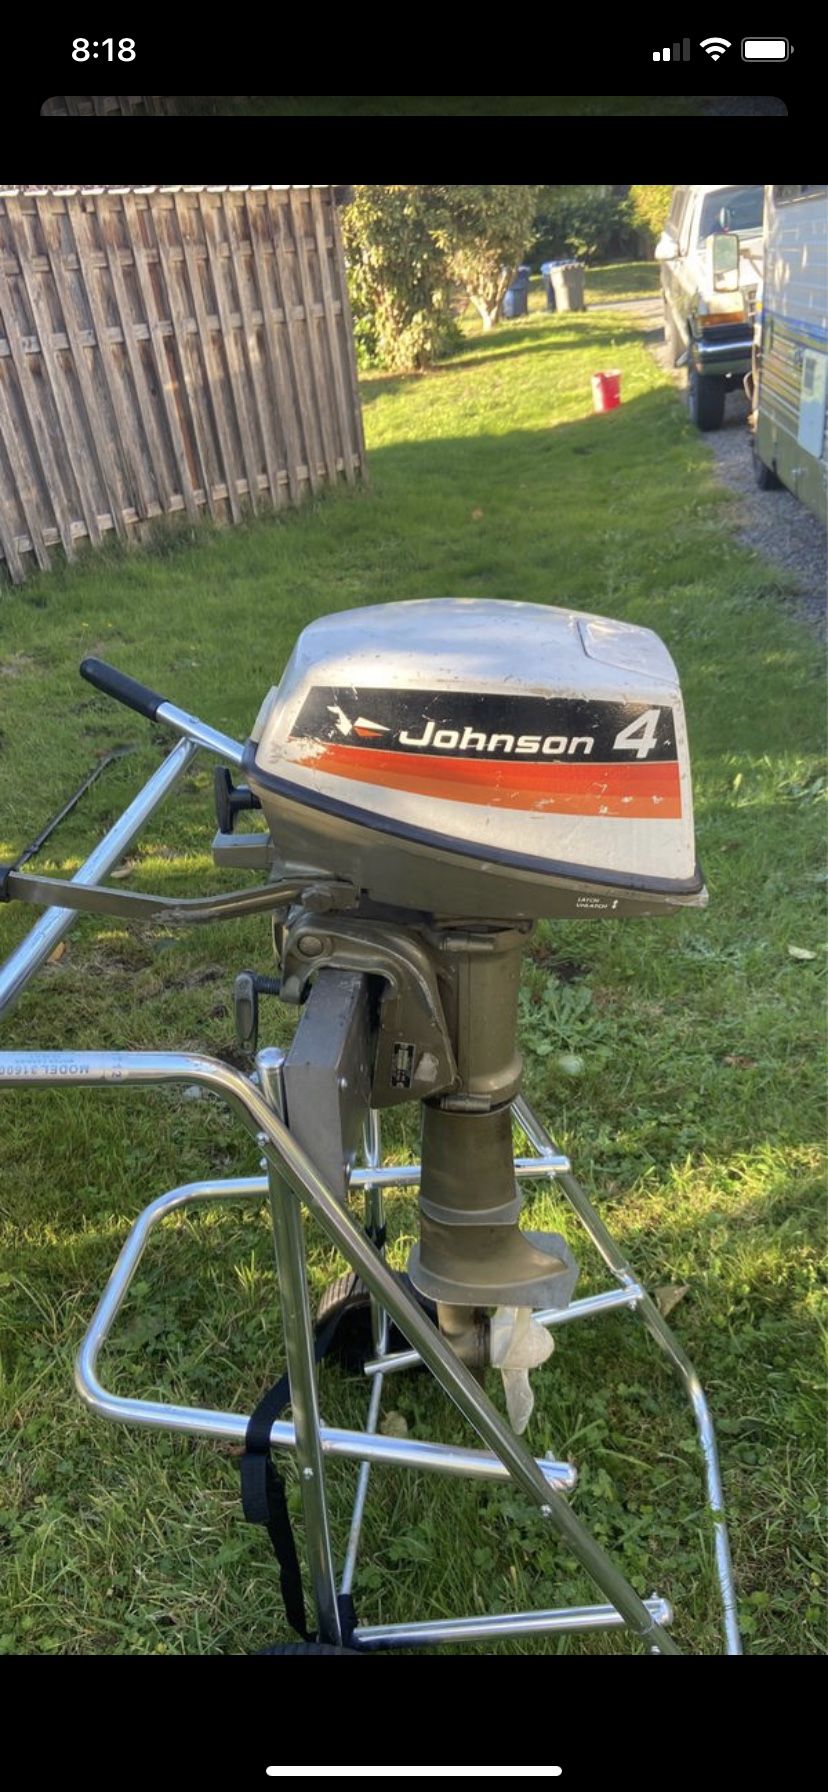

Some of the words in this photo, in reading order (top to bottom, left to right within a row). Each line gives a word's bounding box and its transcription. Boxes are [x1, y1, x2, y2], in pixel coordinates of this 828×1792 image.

[398, 721, 595, 755] Johnson
[612, 708, 661, 760] 4
[42, 1064, 89, 1075] MODEL
